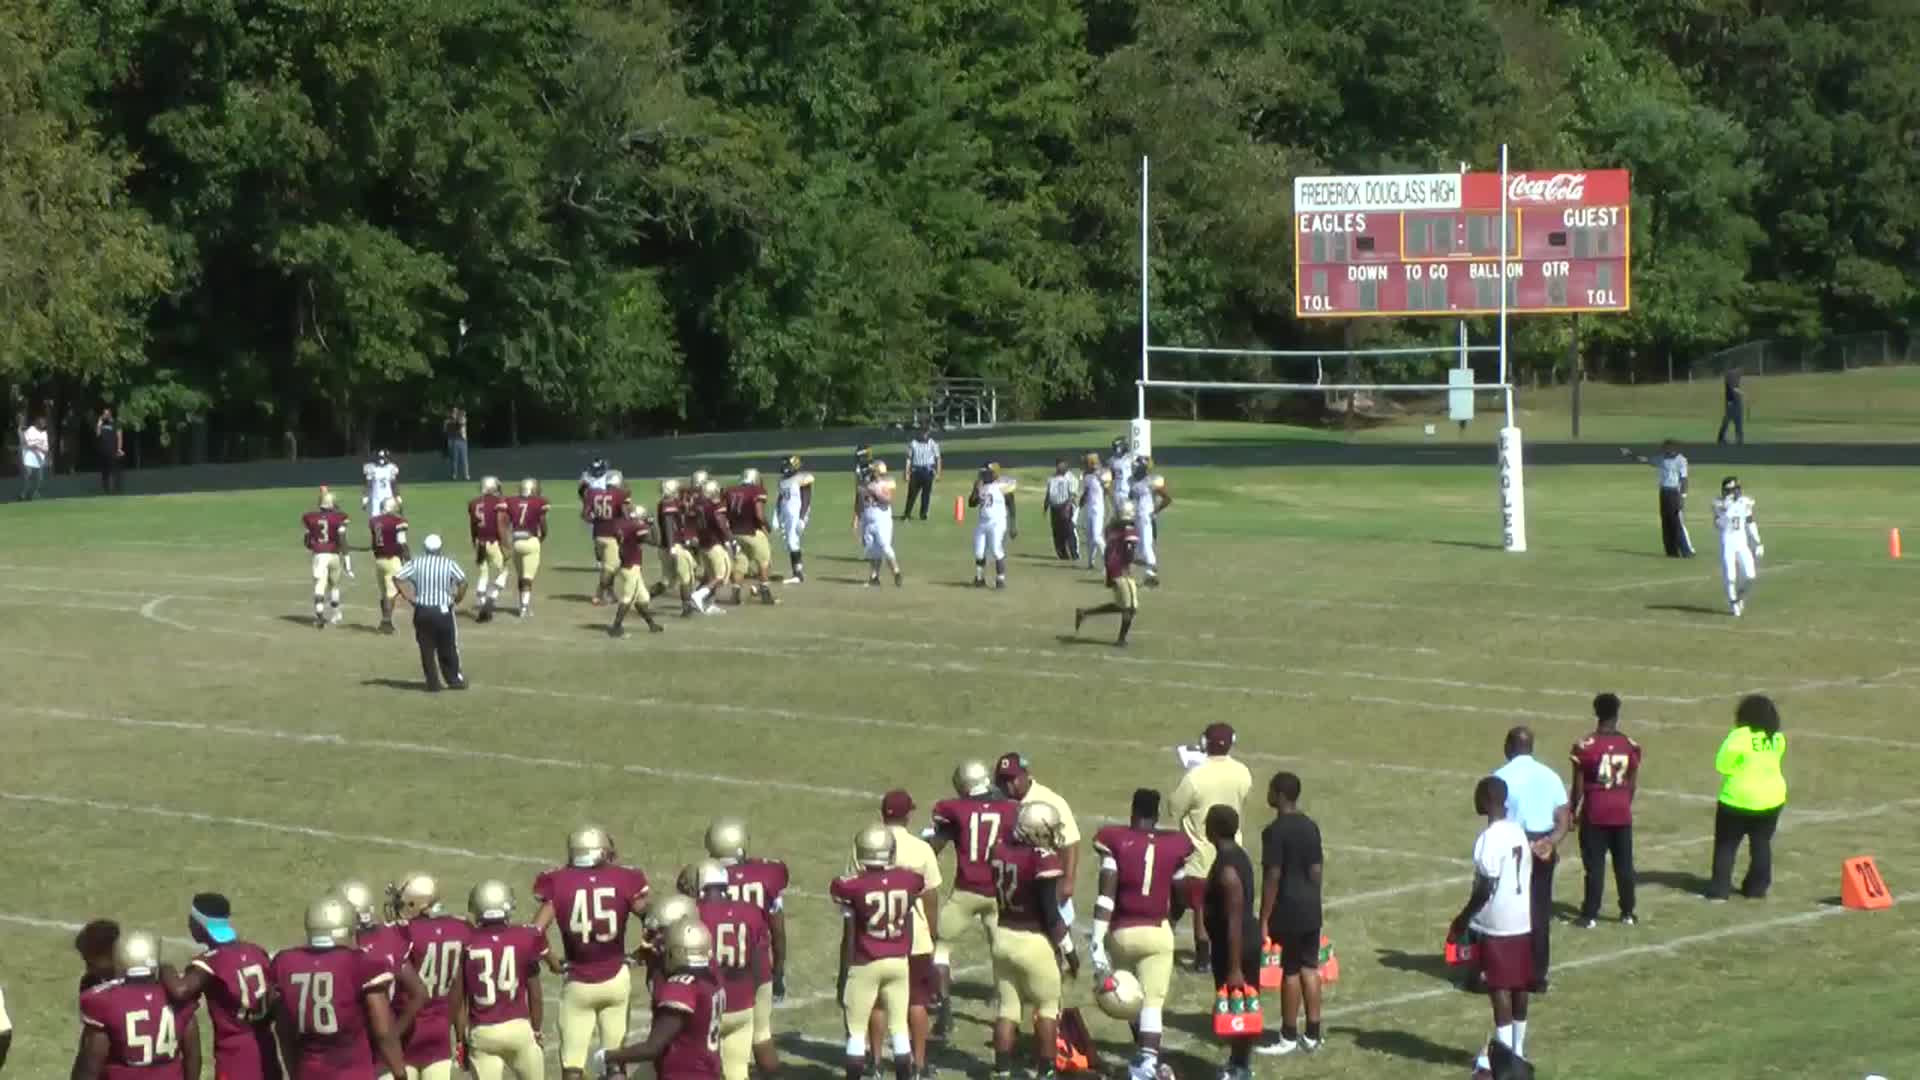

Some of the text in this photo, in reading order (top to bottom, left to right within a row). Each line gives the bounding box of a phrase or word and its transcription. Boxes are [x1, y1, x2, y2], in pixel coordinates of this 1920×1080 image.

[1300, 179, 1456, 206] FREDERICK DOUGLASS HIGH
[1300, 213, 1366, 233] EAGLES
[1563, 207, 1619, 227] GUEST
[1347, 265, 1388, 281] DOWN
[1404, 264, 1449, 280] TO GO
[1507, 262, 1524, 278] ON
[317, 519, 329, 545] 3
[518, 503, 529, 528] 7
[1598, 753, 1630, 790] 47
[969, 811, 1001, 862] 17
[1142, 844, 1155, 896] 1
[570, 886, 619, 944] 45
[865, 889, 909, 939] 20
[716, 922, 748, 969] 61
[419, 940, 461, 999] 40
[470, 944, 520, 1007] 34
[290, 971, 339, 1035] 78
[125, 1009, 176, 1066] 54
[1231, 1016, 1246, 1031] G
